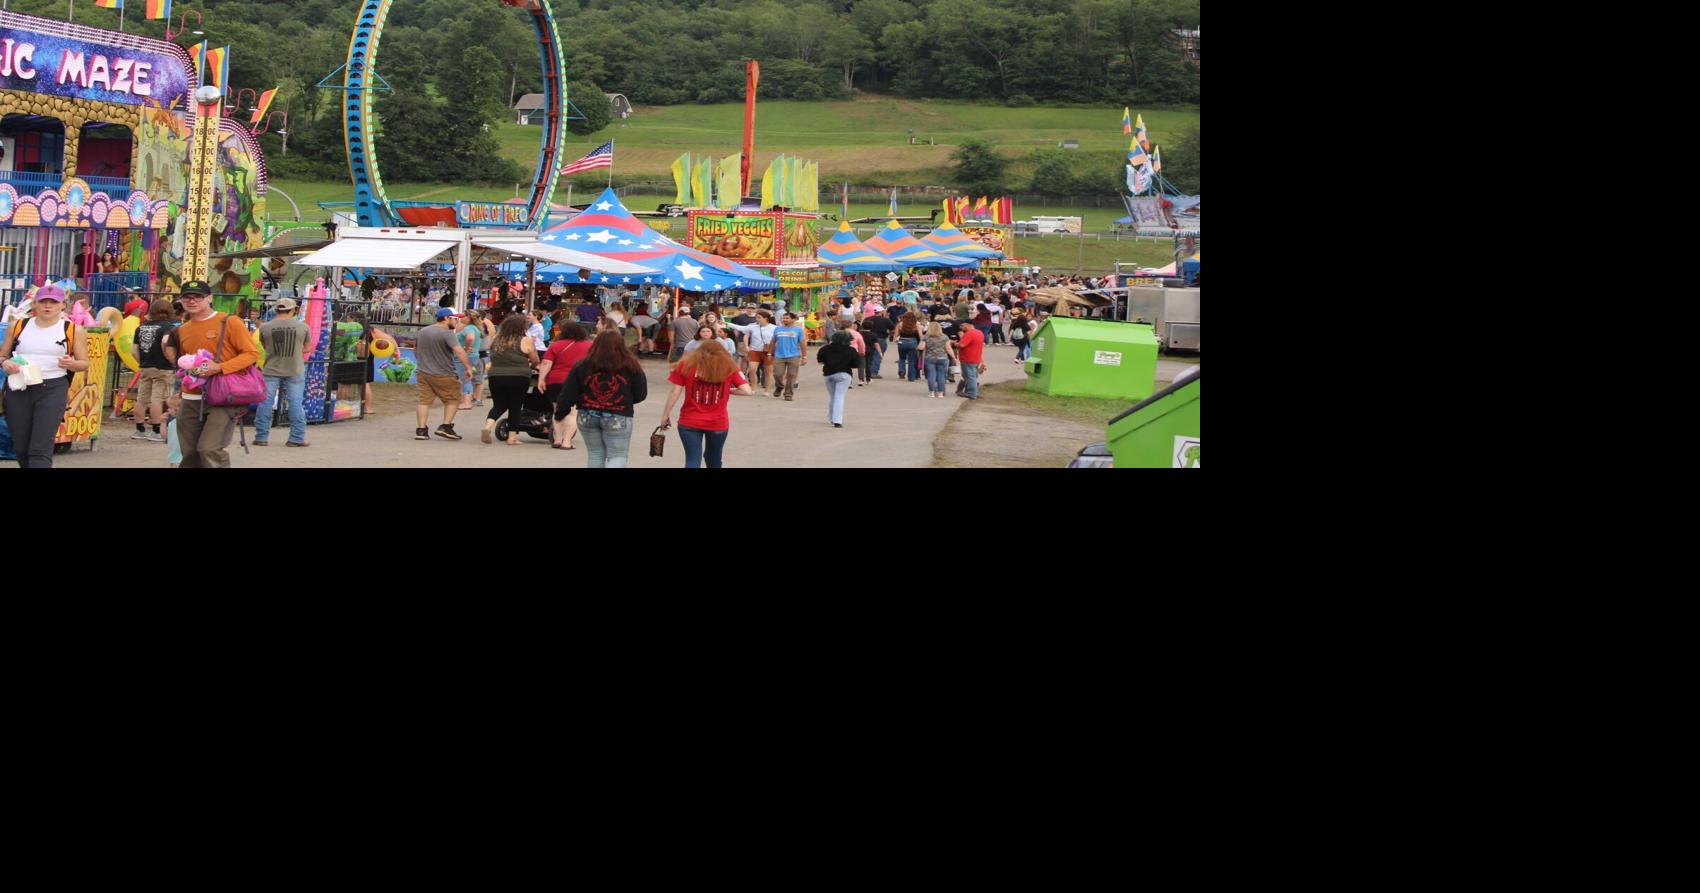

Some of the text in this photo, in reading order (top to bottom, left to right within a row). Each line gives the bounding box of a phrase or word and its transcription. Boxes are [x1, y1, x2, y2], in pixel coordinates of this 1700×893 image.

[0, 38, 152, 96] IC MAZE
[491, 204, 501, 222] OF
[697, 216, 773, 238] FRIED VEGGIES
[66, 415, 98, 436] DOG
